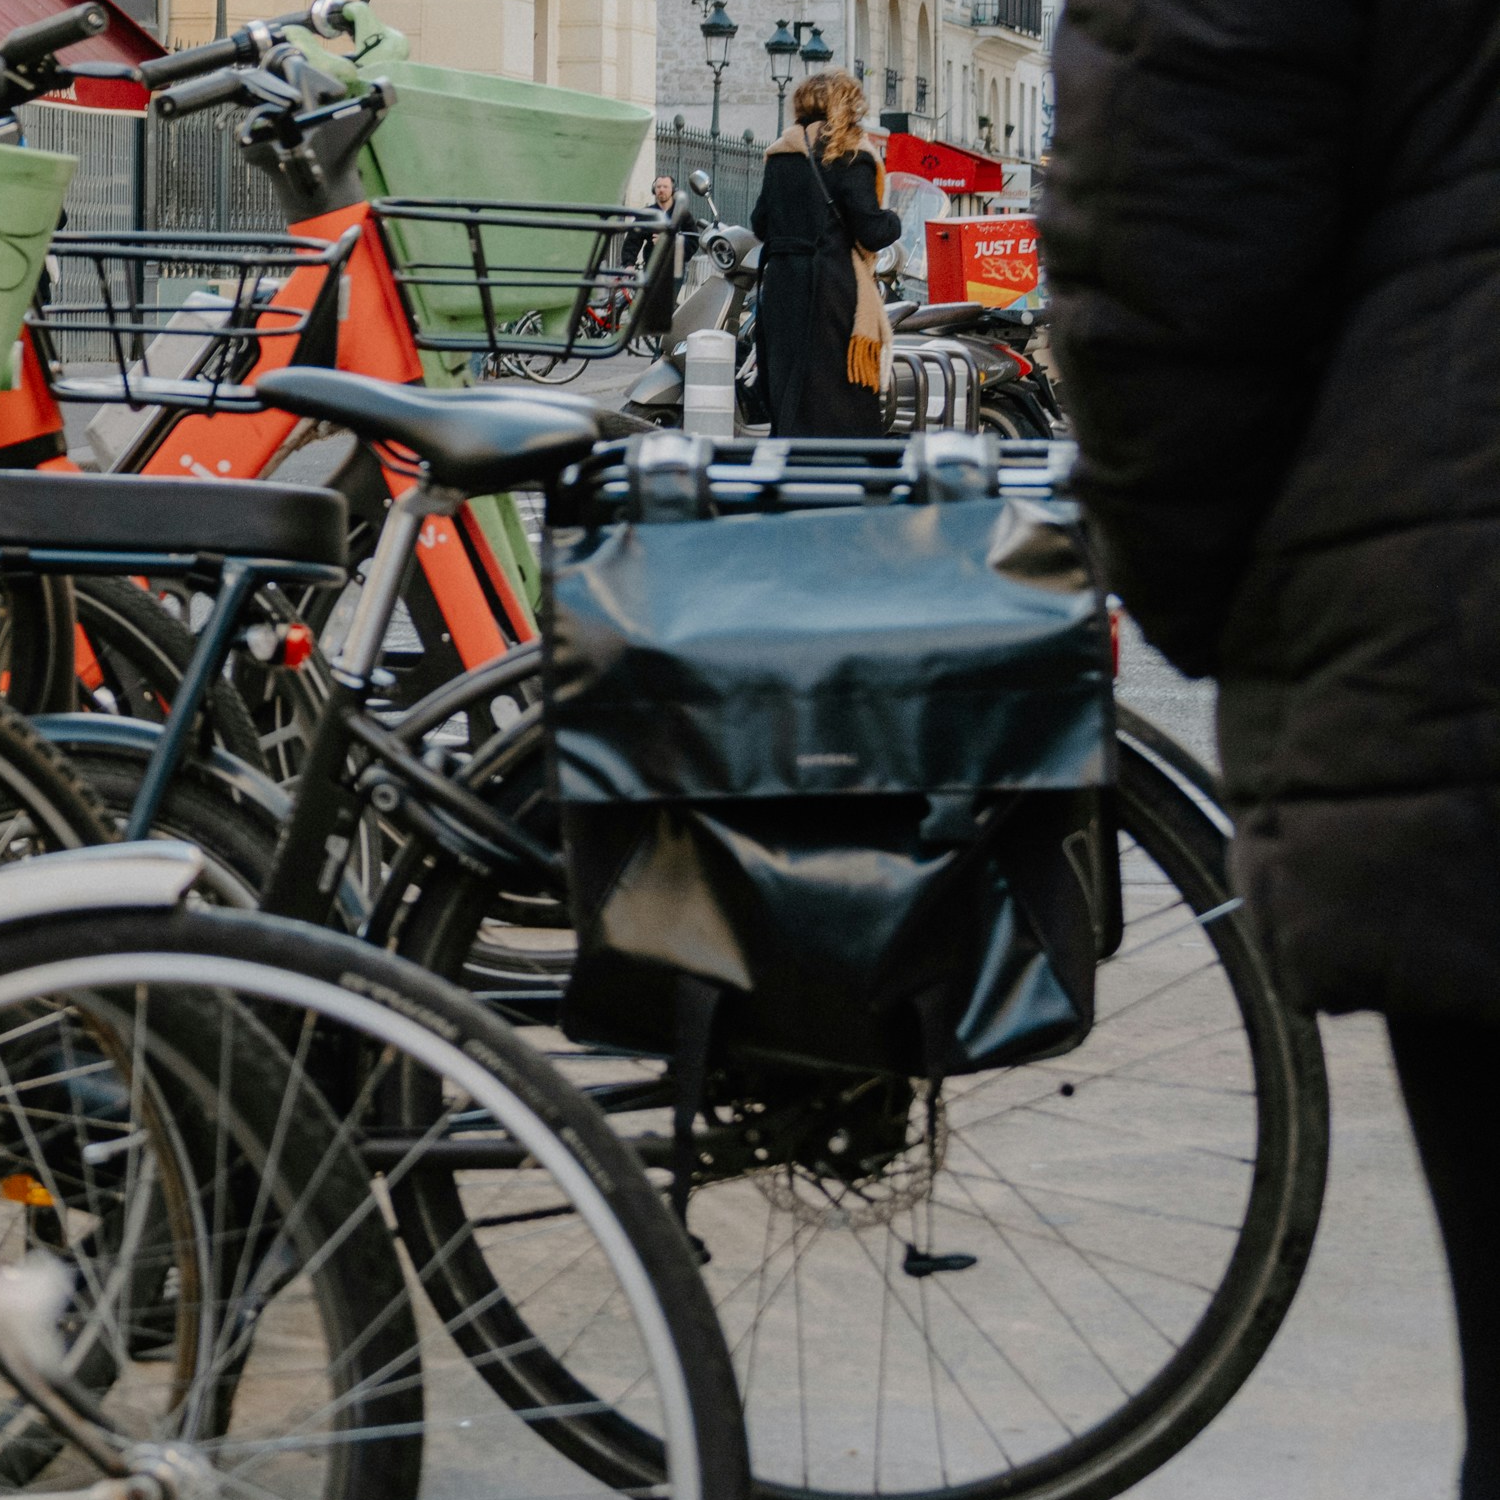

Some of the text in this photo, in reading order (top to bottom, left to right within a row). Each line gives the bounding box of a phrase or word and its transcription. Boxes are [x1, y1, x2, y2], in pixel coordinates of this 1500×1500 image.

[933, 177, 966, 188] Bistrot
[974, 238, 1038, 259] JUST EA
